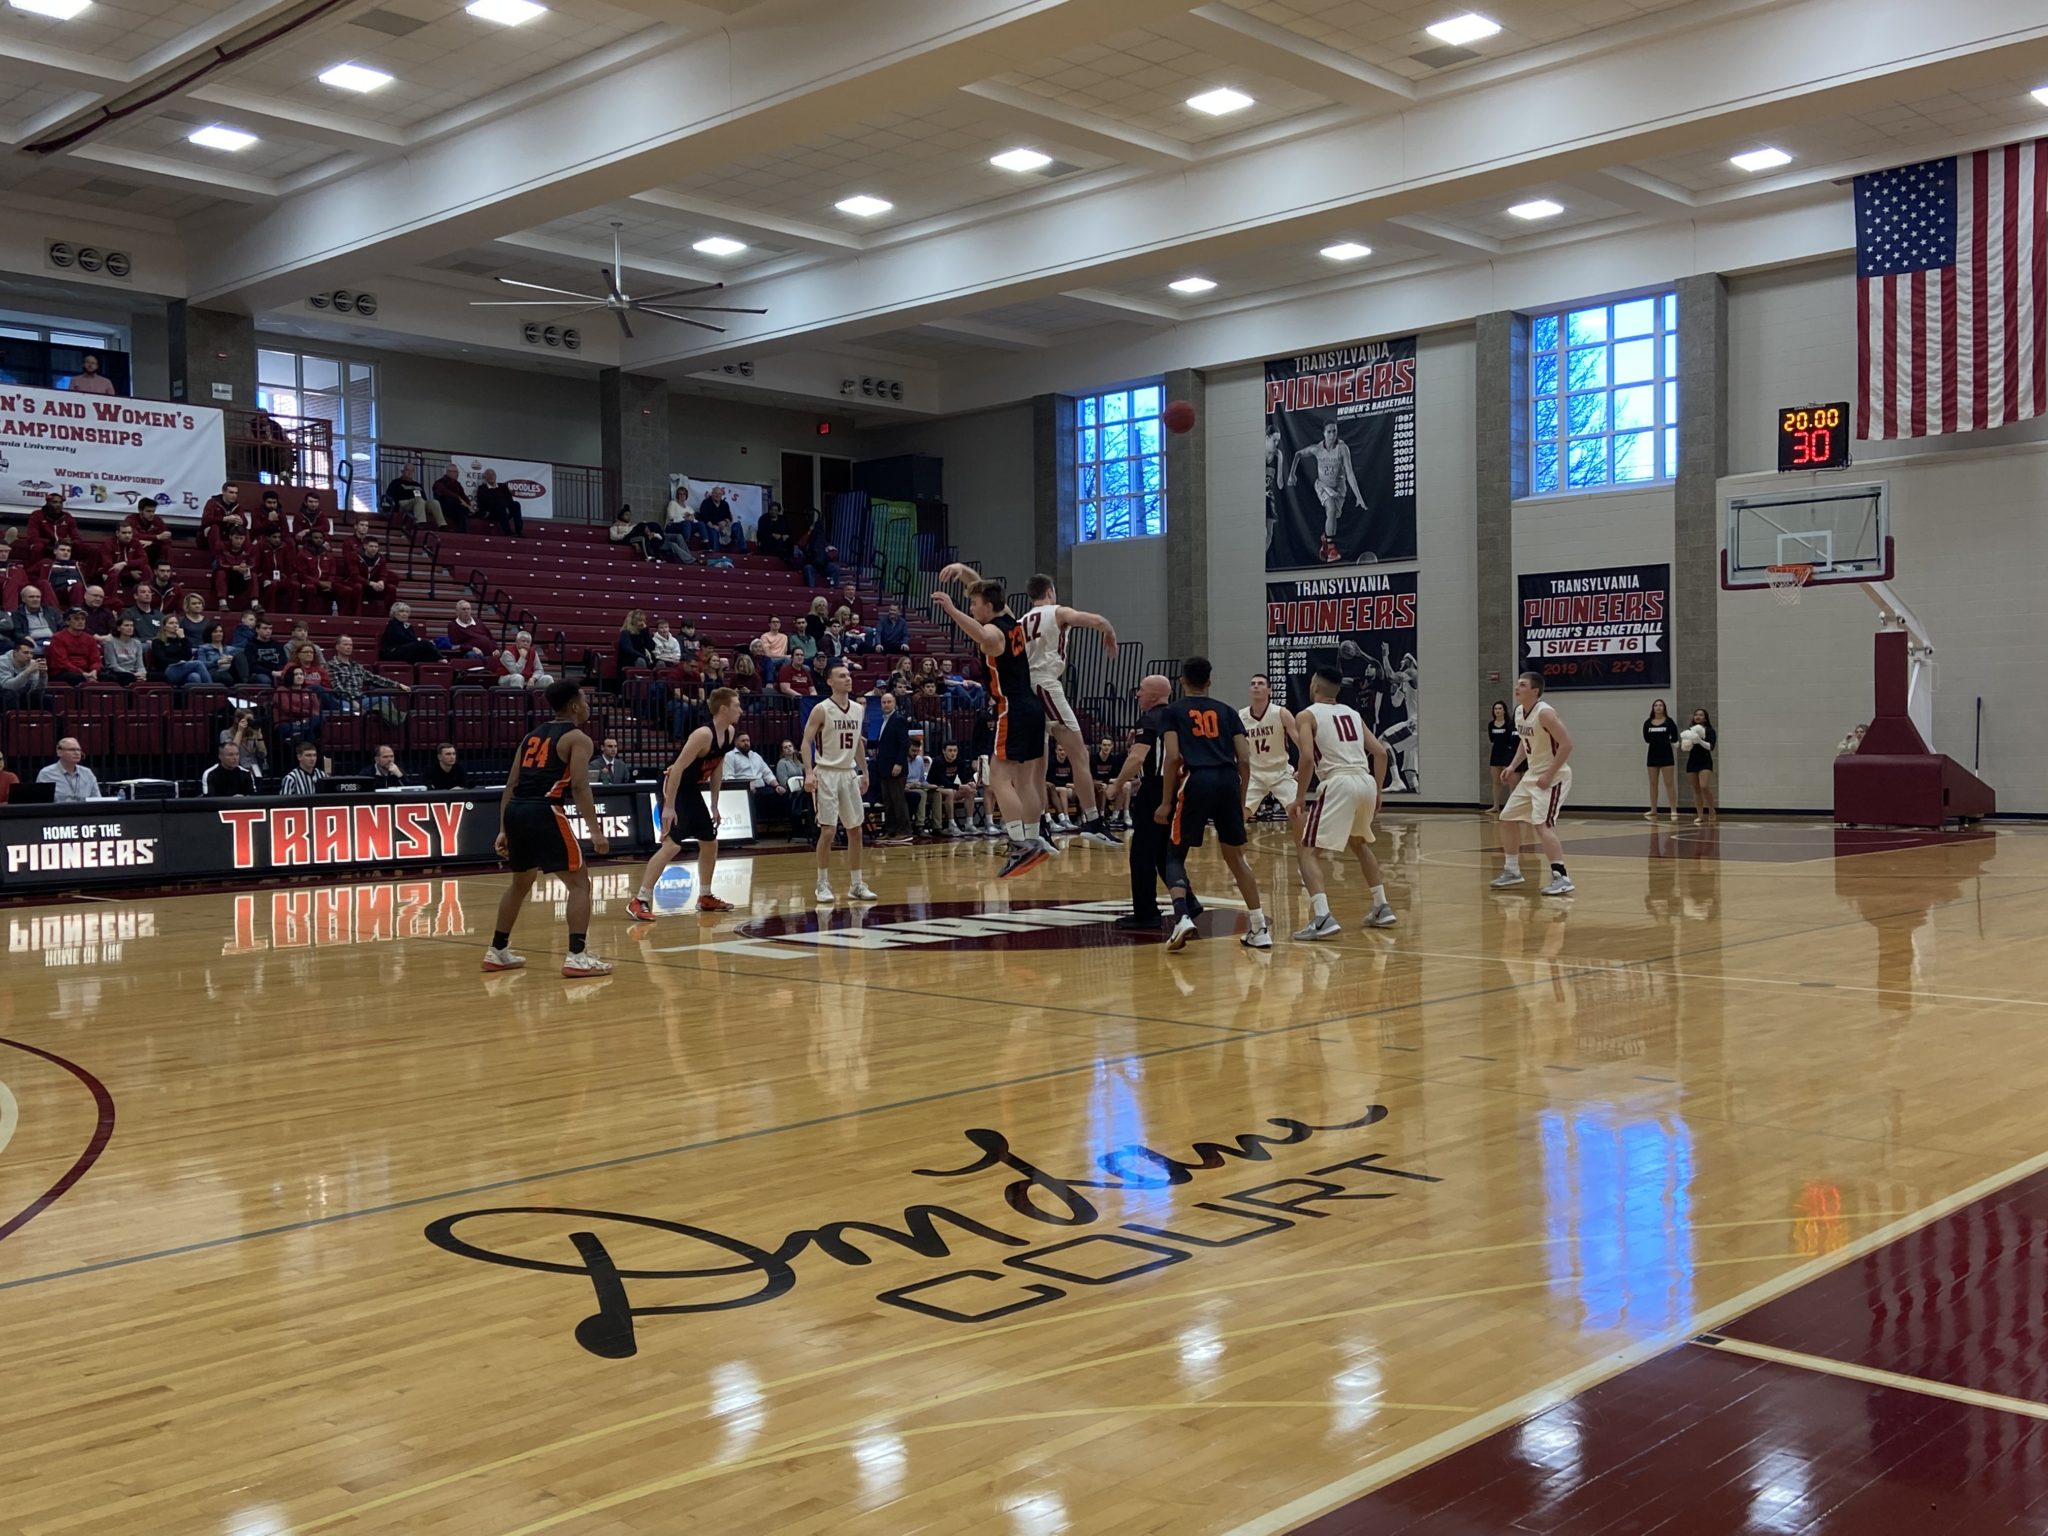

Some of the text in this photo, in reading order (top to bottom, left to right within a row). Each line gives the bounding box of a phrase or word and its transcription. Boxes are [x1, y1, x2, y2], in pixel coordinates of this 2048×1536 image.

[1294, 342, 1390, 372] TRANSYLVANIA
[1266, 358, 1415, 414] PIONEERS
[43, 400, 86, 419] AND
[92, 402, 194, 430] WOMEN'S
[1337, 396, 1414, 415] WOMEN'S BASKETBALL
[0, 419, 143, 447] AMPIONSHIPS
[1392, 430, 1414, 440] 2000
[24, 442, 76, 454] University
[1392, 438, 1414, 448] 2002
[1793, 429, 1830, 463] 30
[1393, 455, 1414, 464] 2007
[101, 472, 165, 485] CHAMPIONSHIP
[1394, 471, 1414, 481] 2014
[1394, 480, 1414, 489] 2015
[1295, 575, 1390, 596] TRANSYLVANIA
[1550, 574, 1640, 593] TRANSYLVANIA
[1268, 593, 1416, 634] PIONEERS
[1523, 590, 1664, 627] PIONEERS
[1022, 612, 1041, 643] 12
[1526, 622, 1663, 640] WOMEN'S BASKETBALL
[1268, 635, 1340, 646] MEN'S BASKETBALL
[1546, 638, 1639, 654] SWEET 16
[1543, 660, 1645, 675] 2019 27-3
[834, 720, 858, 730] TRANSY
[1188, 709, 1219, 739] 30
[1332, 714, 1358, 742] 10
[840, 733, 853, 750] 15
[1255, 738, 1270, 754] 14
[521, 736, 551, 769] 24
[43, 824, 122, 840] HOME OF THE
[7, 838, 154, 873] PIONEERS
[877, 1153, 1444, 1323] COURT
